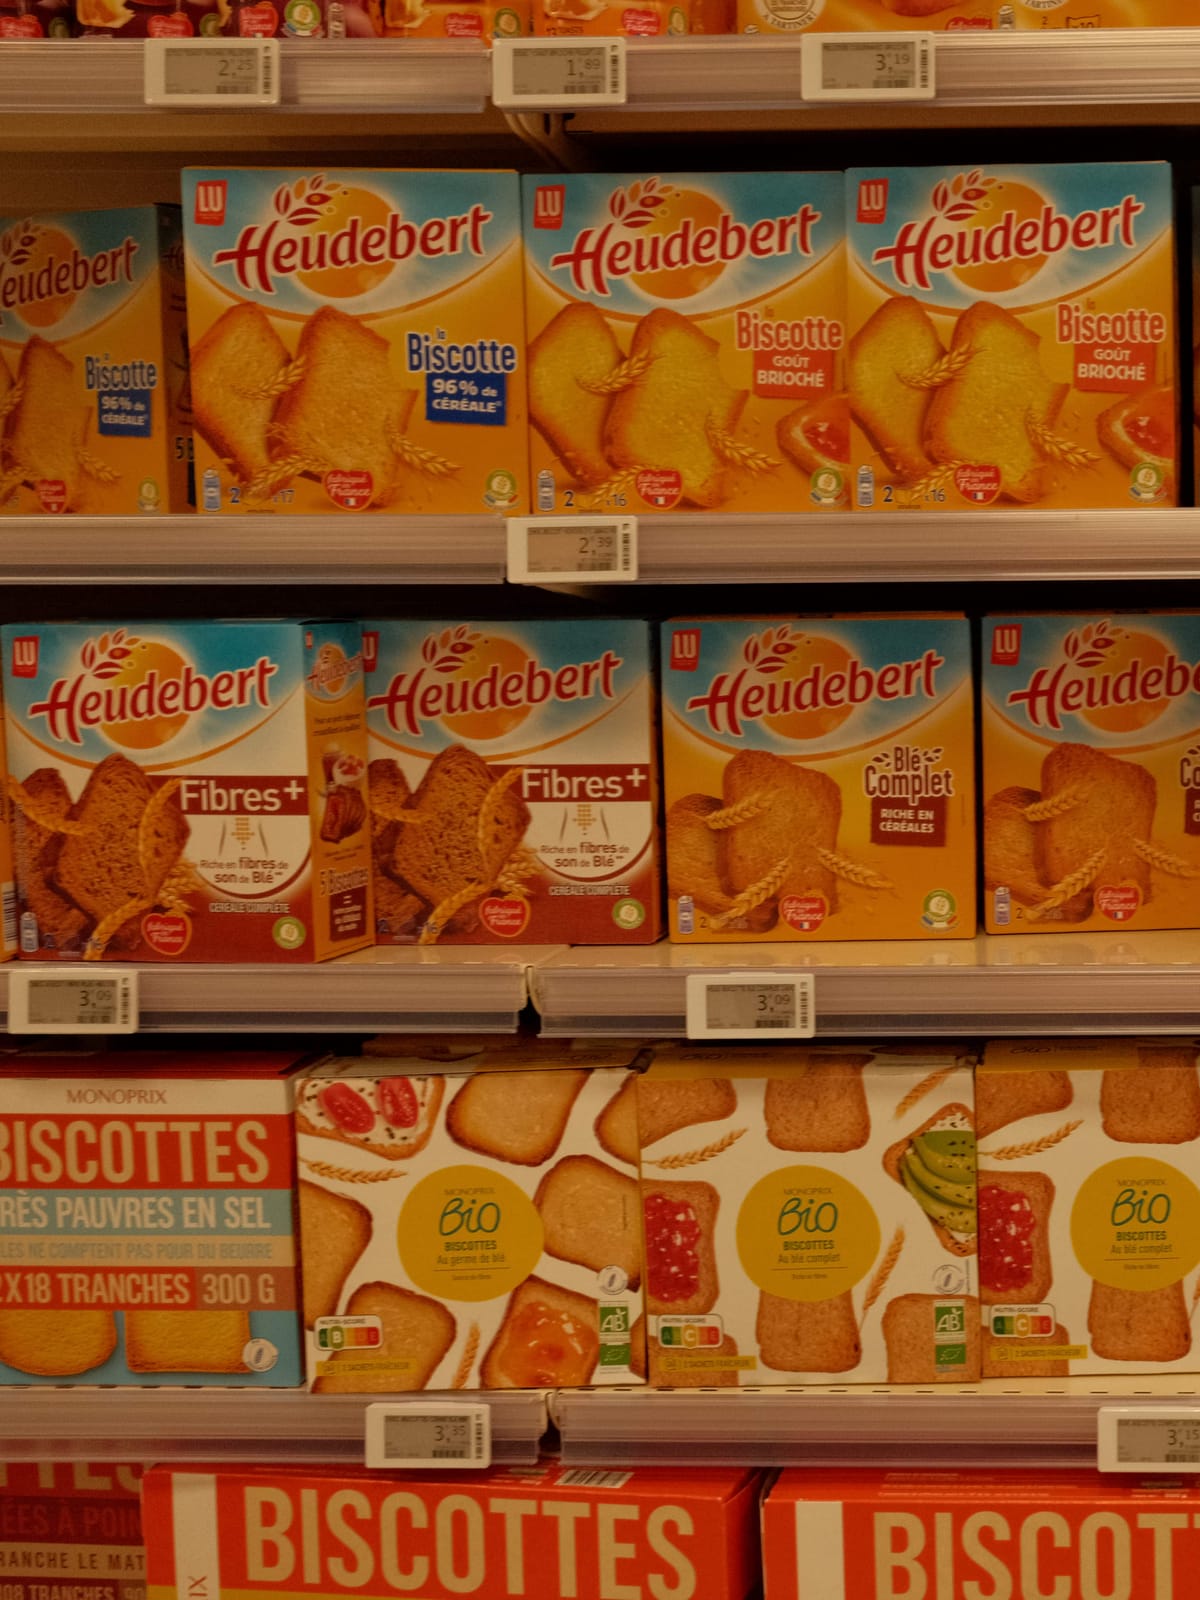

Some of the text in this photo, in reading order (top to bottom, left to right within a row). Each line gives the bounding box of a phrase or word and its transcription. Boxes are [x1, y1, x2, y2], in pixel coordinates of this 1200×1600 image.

[198, 183, 224, 212] LU
[536, 187, 563, 218] LU
[860, 182, 885, 212] LU
[214, 207, 491, 294] Heudebert
[552, 206, 821, 295] Heudebert
[873, 197, 1145, 290] Heudebert
[0, 237, 139, 308] eudebert
[736, 311, 843, 350] Biscotte
[1057, 304, 1166, 343] Biscotte
[407, 333, 516, 373] Biscotte
[772, 354, 810, 369] GOÛT
[1093, 347, 1131, 362] GOÛT
[84, 356, 157, 390] Biscotte
[757, 369, 825, 388] BRIOCHÉ
[1077, 362, 1147, 382] BRIOCHÉ
[230, 488, 240, 503] 2
[883, 485, 893, 503] 2
[15, 641, 37, 666] LU
[362, 635, 375, 662] U
[673, 634, 696, 659] LU
[994, 629, 1017, 653] LU
[29, 657, 278, 744] Heudebert
[368, 652, 623, 736] Heudebert
[688, 651, 944, 736] Heudebert
[893, 746, 920, 773] Blé
[180, 779, 305, 811] Fibres+
[522, 768, 647, 798] Fibres+
[864, 764, 954, 806] Complet
[879, 820, 934, 833] CÉRÉALES
[880, 809, 934, 821] RICHE EN
[67, 1089, 168, 1105] MONOPRIX
[56, 1196, 174, 1230] PAUVRES
[182, 1197, 216, 1229] EN
[224, 1196, 271, 1229] SEL
[439, 1197, 501, 1237] Bio
[777, 1197, 838, 1236] Bio
[1111, 1188, 1172, 1228] Bio
[51, 1243, 123, 1259] COMPTENT
[127, 1243, 153, 1259] PAS
[156, 1243, 193, 1259] POUR
[199, 1243, 217, 1259] DU
[219, 1243, 272, 1259] BEURRE
[445, 1240, 497, 1252] BISCOTTES
[783, 1239, 834, 1251] BISCOTTES
[1116, 1231, 1167, 1242] BISCOTTES
[1139, 1243, 1172, 1256] complet
[805, 1251, 841, 1265] complet
[0, 1272, 190, 1304] X18 TRANCHES
[201, 1273, 276, 1304] 300 G
[684, 1329, 695, 1342] C
[936, 1313, 961, 1332] AB
[243, 1486, 697, 1600] BISCOTTES
[79, 1553, 98, 1569] LE
